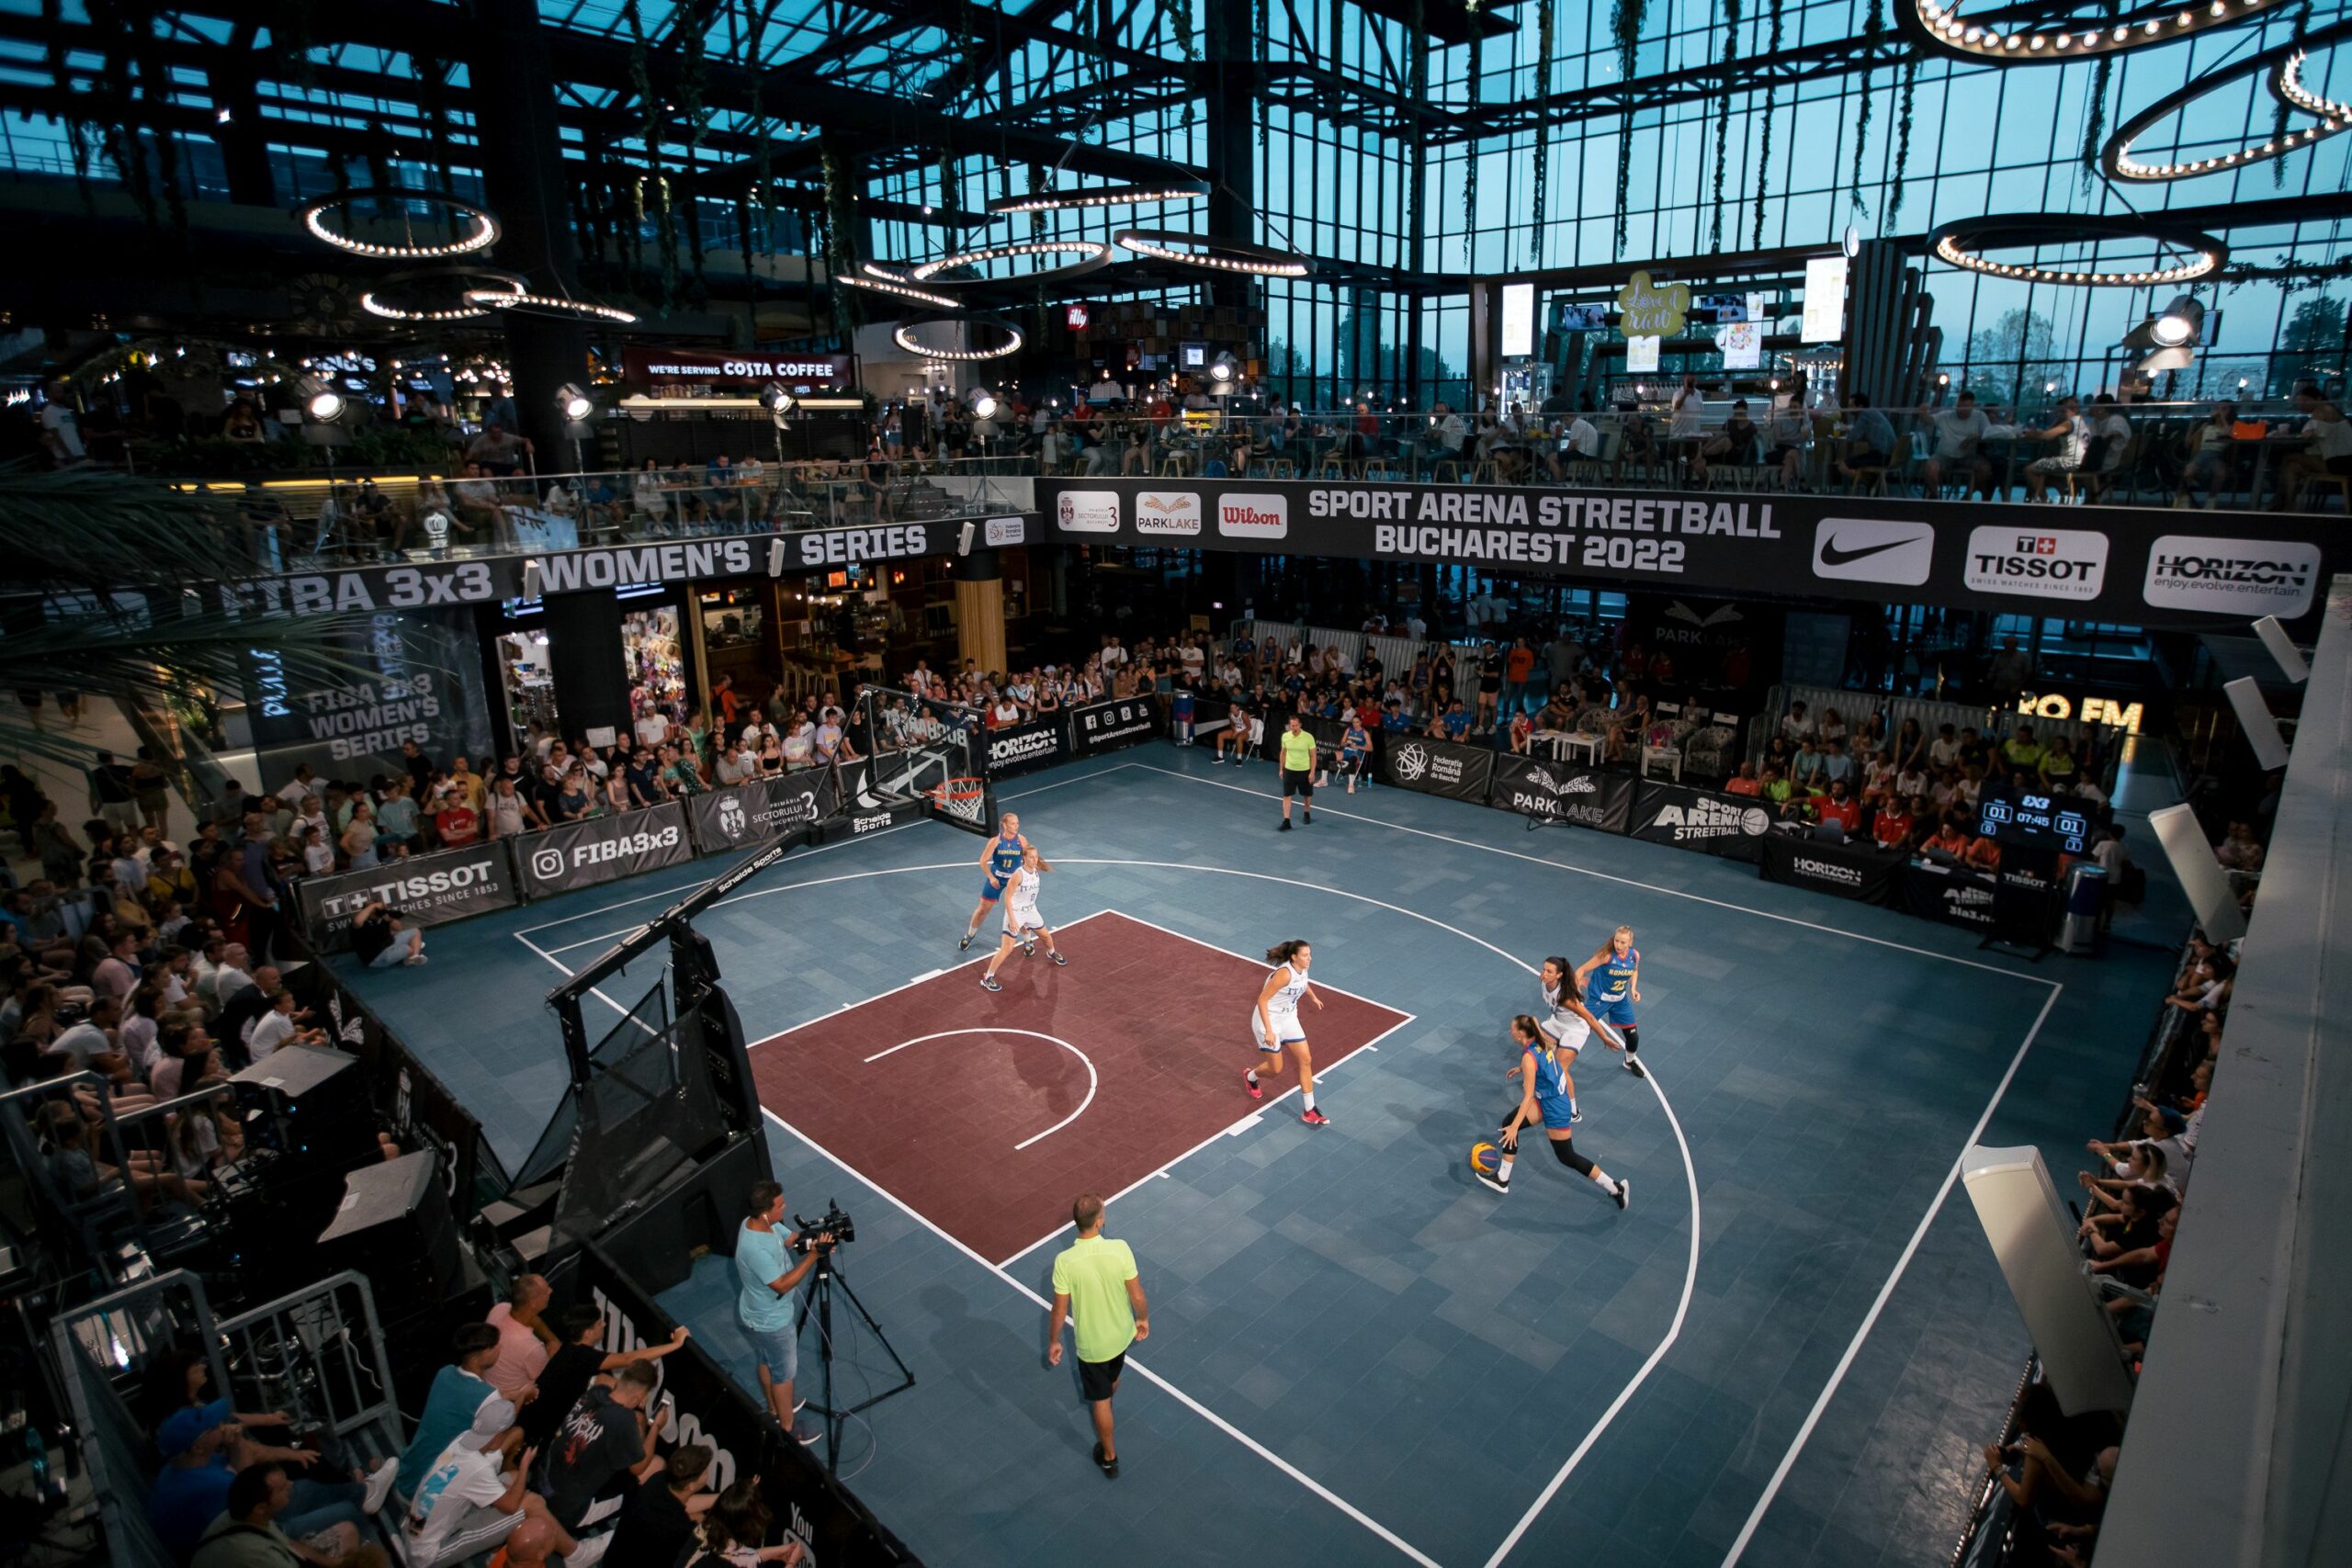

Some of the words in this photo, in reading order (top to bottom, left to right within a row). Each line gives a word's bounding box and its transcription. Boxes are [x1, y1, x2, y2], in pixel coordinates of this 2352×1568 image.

[1069, 308, 1087, 329] illy
[649, 366, 680, 375] WE'RE
[682, 366, 720, 376] SERVING
[723, 362, 773, 378] COSTA
[776, 363, 833, 378] COFFEE
[795, 386, 810, 394] COSTA
[1108, 506, 1117, 526] 3
[1138, 517, 1199, 529] PARKLAKE
[1223, 506, 1281, 525] Wilson
[1308, 490, 1412, 521] SPORT
[1418, 493, 1529, 525] ARENA
[1538, 497, 1781, 538] STREETBALL
[536, 540, 751, 593] WOMEN'S
[801, 525, 928, 564] SERIES
[1375, 525, 1576, 565] BUCHAREST
[1582, 536, 1685, 573] 2022
[1975, 555, 2097, 581] TISSOT
[2156, 555, 2308, 586] HORIZON
[385, 562, 493, 608] 3x3
[2001, 580, 2040, 589] WATCHES
[2043, 583, 2069, 592] SINCE
[308, 682, 377, 713] FIBA
[310, 697, 439, 739] WOMEN'S
[2080, 696, 2144, 735] FM
[331, 723, 430, 761] SERIES
[1089, 721, 1151, 744] @SportArenaStreetball
[1432, 763, 1461, 776] Română
[1433, 755, 1463, 768] Federația
[1439, 773, 1460, 784] Baschet
[770, 797, 800, 808] PRIMĂRIA
[1513, 792, 1604, 823] PARKLAKE
[1697, 797, 1742, 816] SPORT
[1989, 807, 2006, 819] 01
[752, 804, 803, 823] SECTORULUI
[1653, 805, 1740, 827] ARENA
[2017, 812, 2050, 827] 07:45
[854, 818, 891, 833] Sports
[1674, 827, 1739, 840] STREETBALL
[2061, 819, 2079, 833] 01
[573, 826, 679, 868] FIBA3x3
[753, 846, 783, 869] Sports
[1794, 856, 1861, 882] HORIZON
[372, 861, 492, 904] TISSOT
[2004, 873, 2047, 888] TISSOT
[435, 889, 471, 905] SINCE
[474, 883, 500, 897] 1853
[791, 1501, 813, 1545] You
